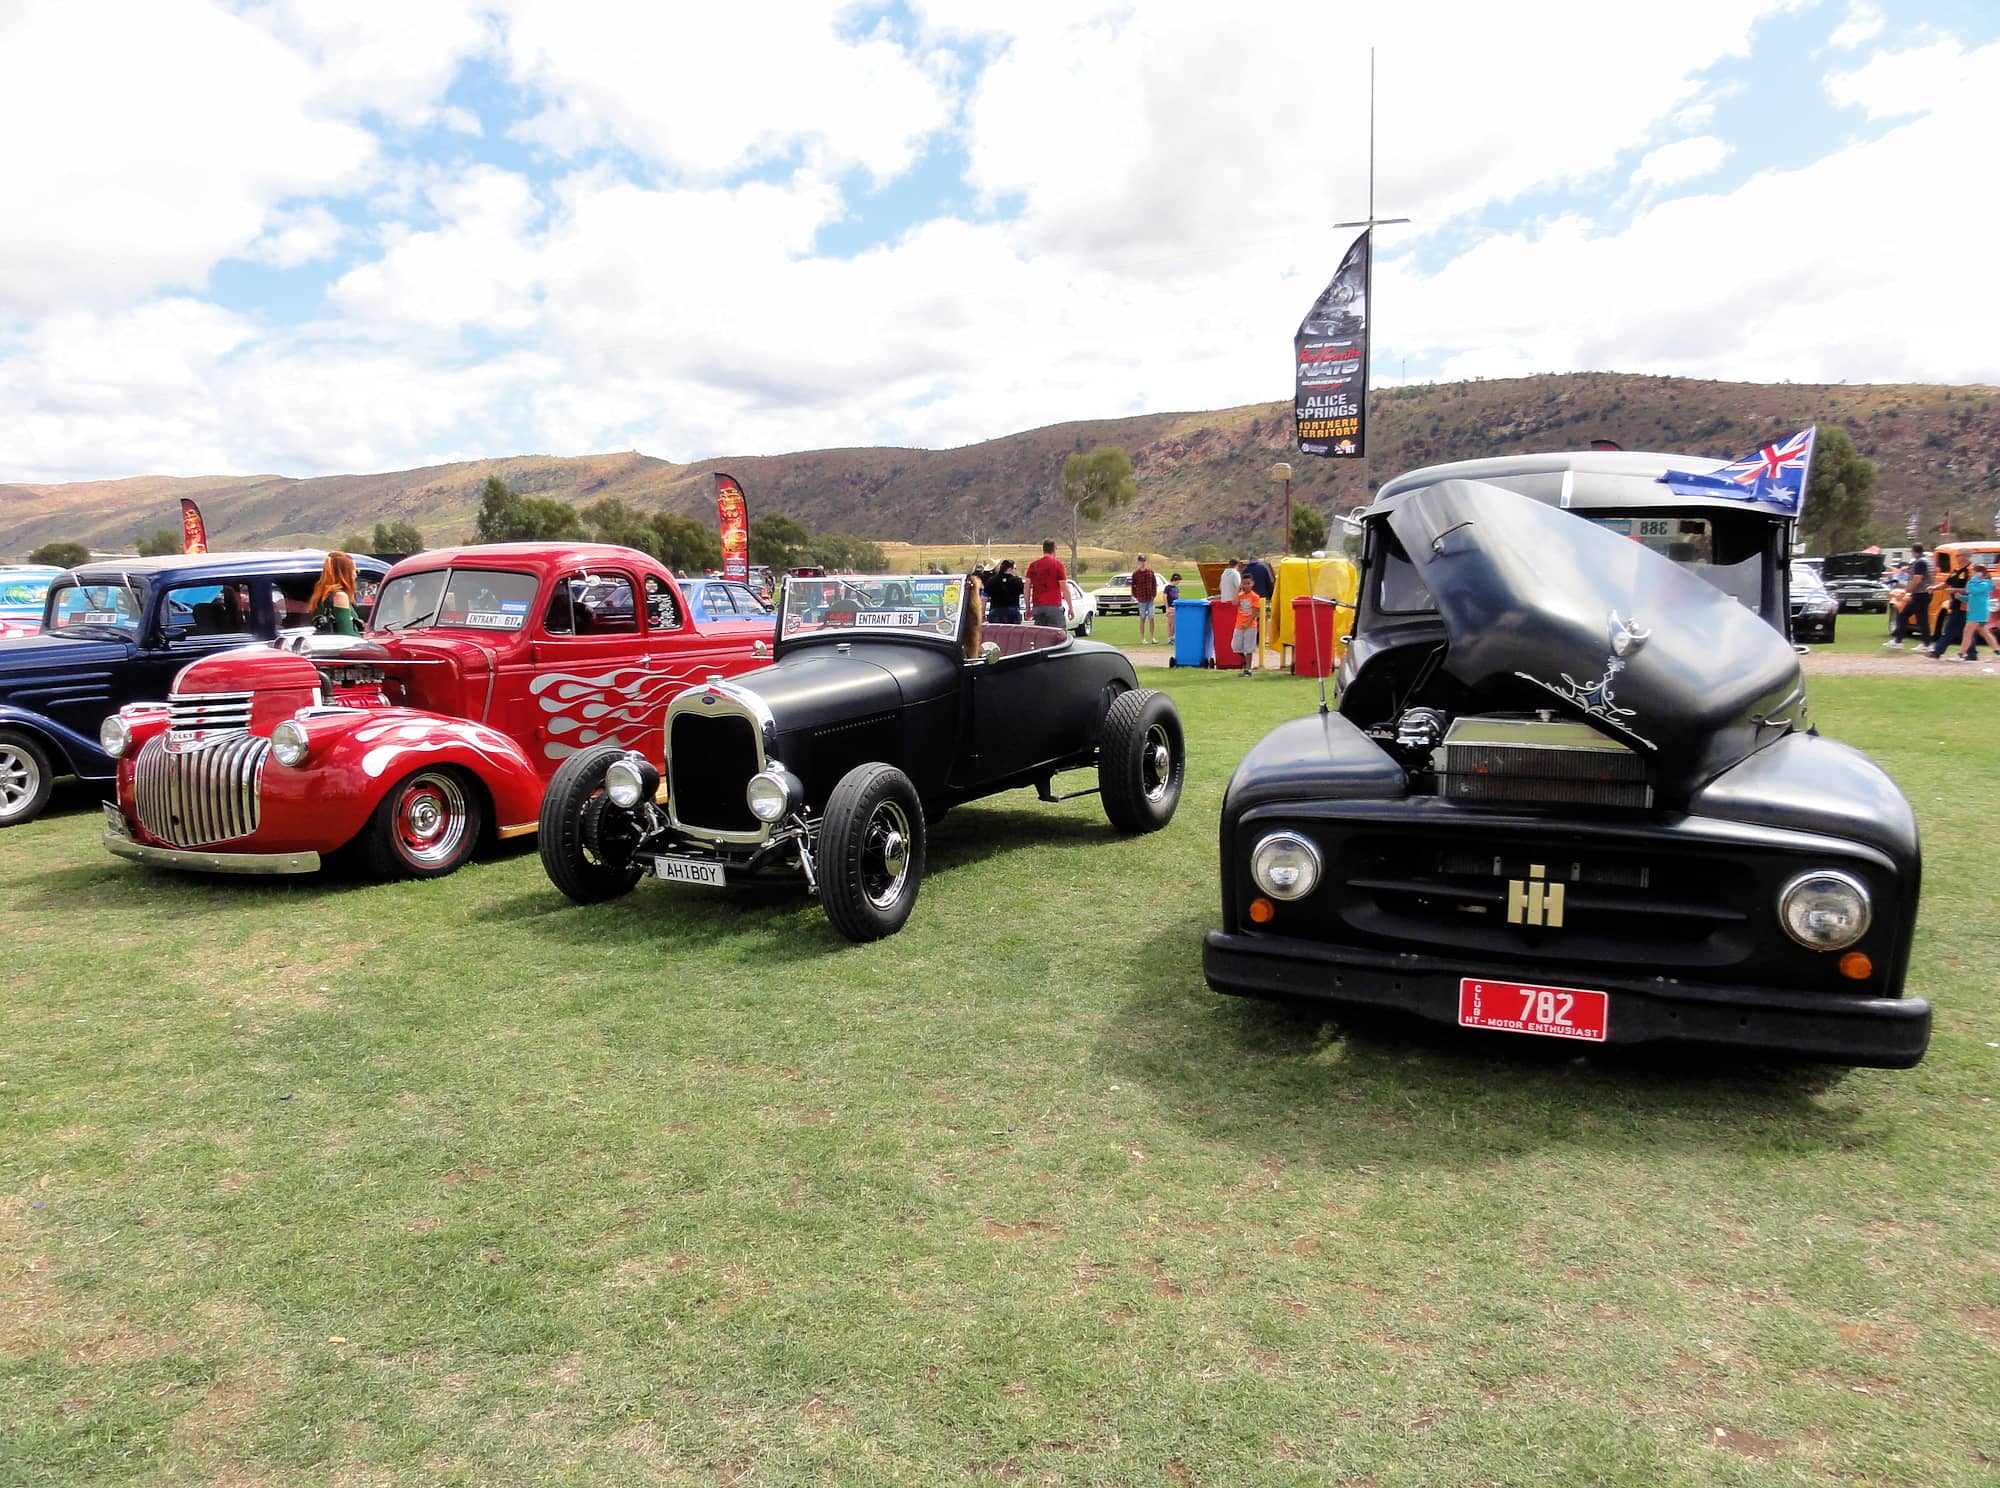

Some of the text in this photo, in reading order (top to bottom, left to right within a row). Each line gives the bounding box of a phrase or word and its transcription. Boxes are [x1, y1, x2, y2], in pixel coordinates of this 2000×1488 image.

[1306, 393, 1347, 408] ALICE
[1296, 404, 1358, 419] SPRINGS
[468, 615, 499, 625] ENTRANT
[858, 613, 891, 625] ENTRANT
[898, 613, 914, 625] 185
[1473, 984, 1483, 1016] CLUB
[1519, 989, 1575, 1026] 782
[1528, 1022, 1599, 1038] ENTHUSIAST
